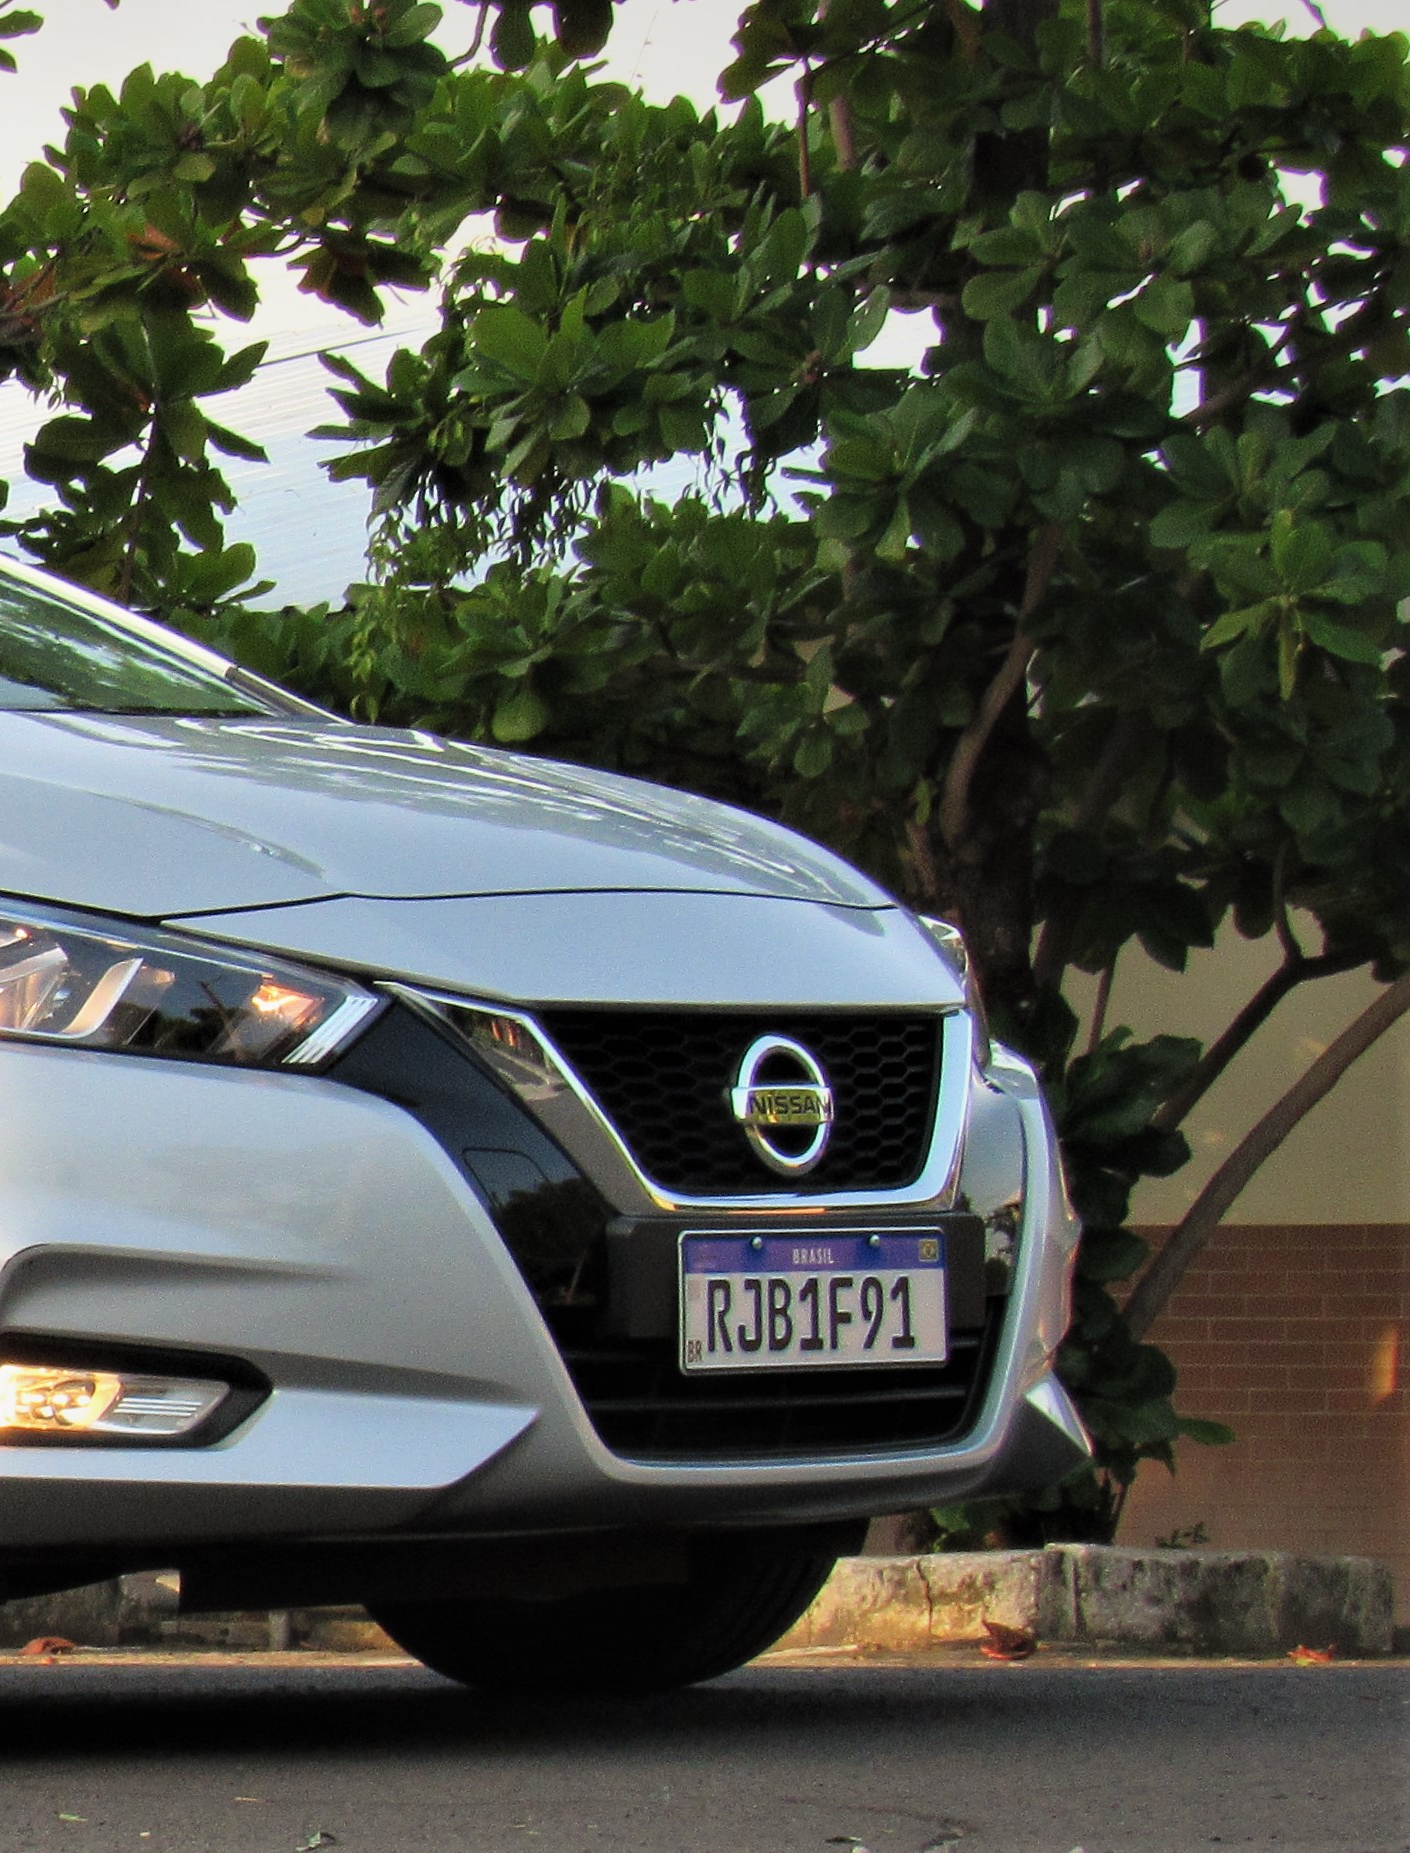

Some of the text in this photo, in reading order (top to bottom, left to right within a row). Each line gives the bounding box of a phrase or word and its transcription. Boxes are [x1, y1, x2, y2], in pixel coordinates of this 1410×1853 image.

[749, 1095, 833, 1116] NISSAN
[791, 1247, 836, 1265] BRASIL
[706, 1275, 915, 1353] RJB1F91
[687, 1340, 702, 1363] BR
